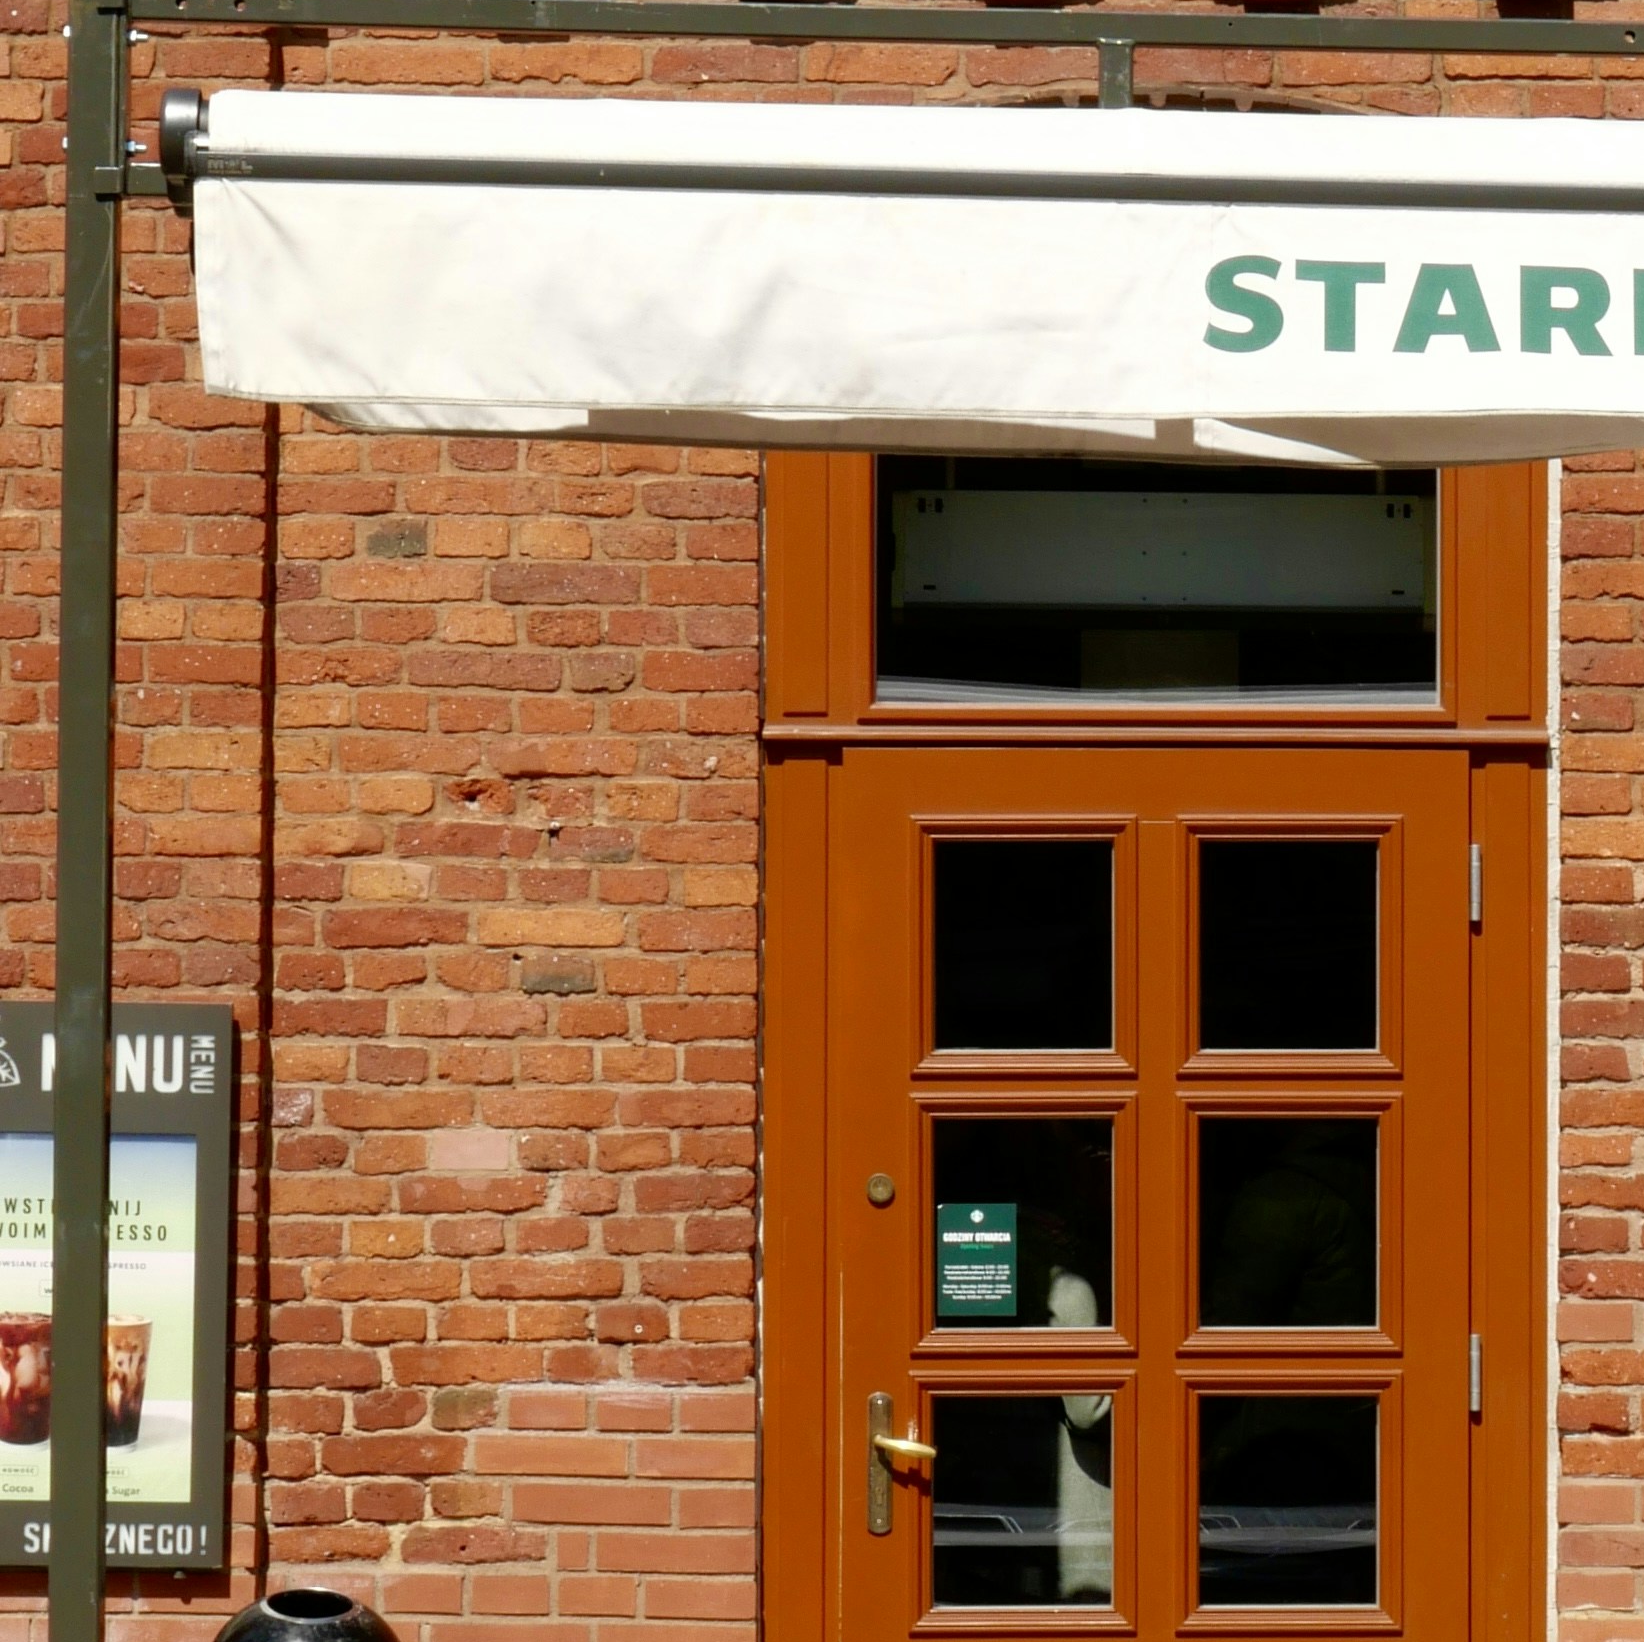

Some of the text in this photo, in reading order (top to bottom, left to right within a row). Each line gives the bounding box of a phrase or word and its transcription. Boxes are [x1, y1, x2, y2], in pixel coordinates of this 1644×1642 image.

[188, 1034, 216, 1094] MENU
[2, 1483, 34, 1493] Cocoa
[112, 1485, 140, 1497] Sugar
